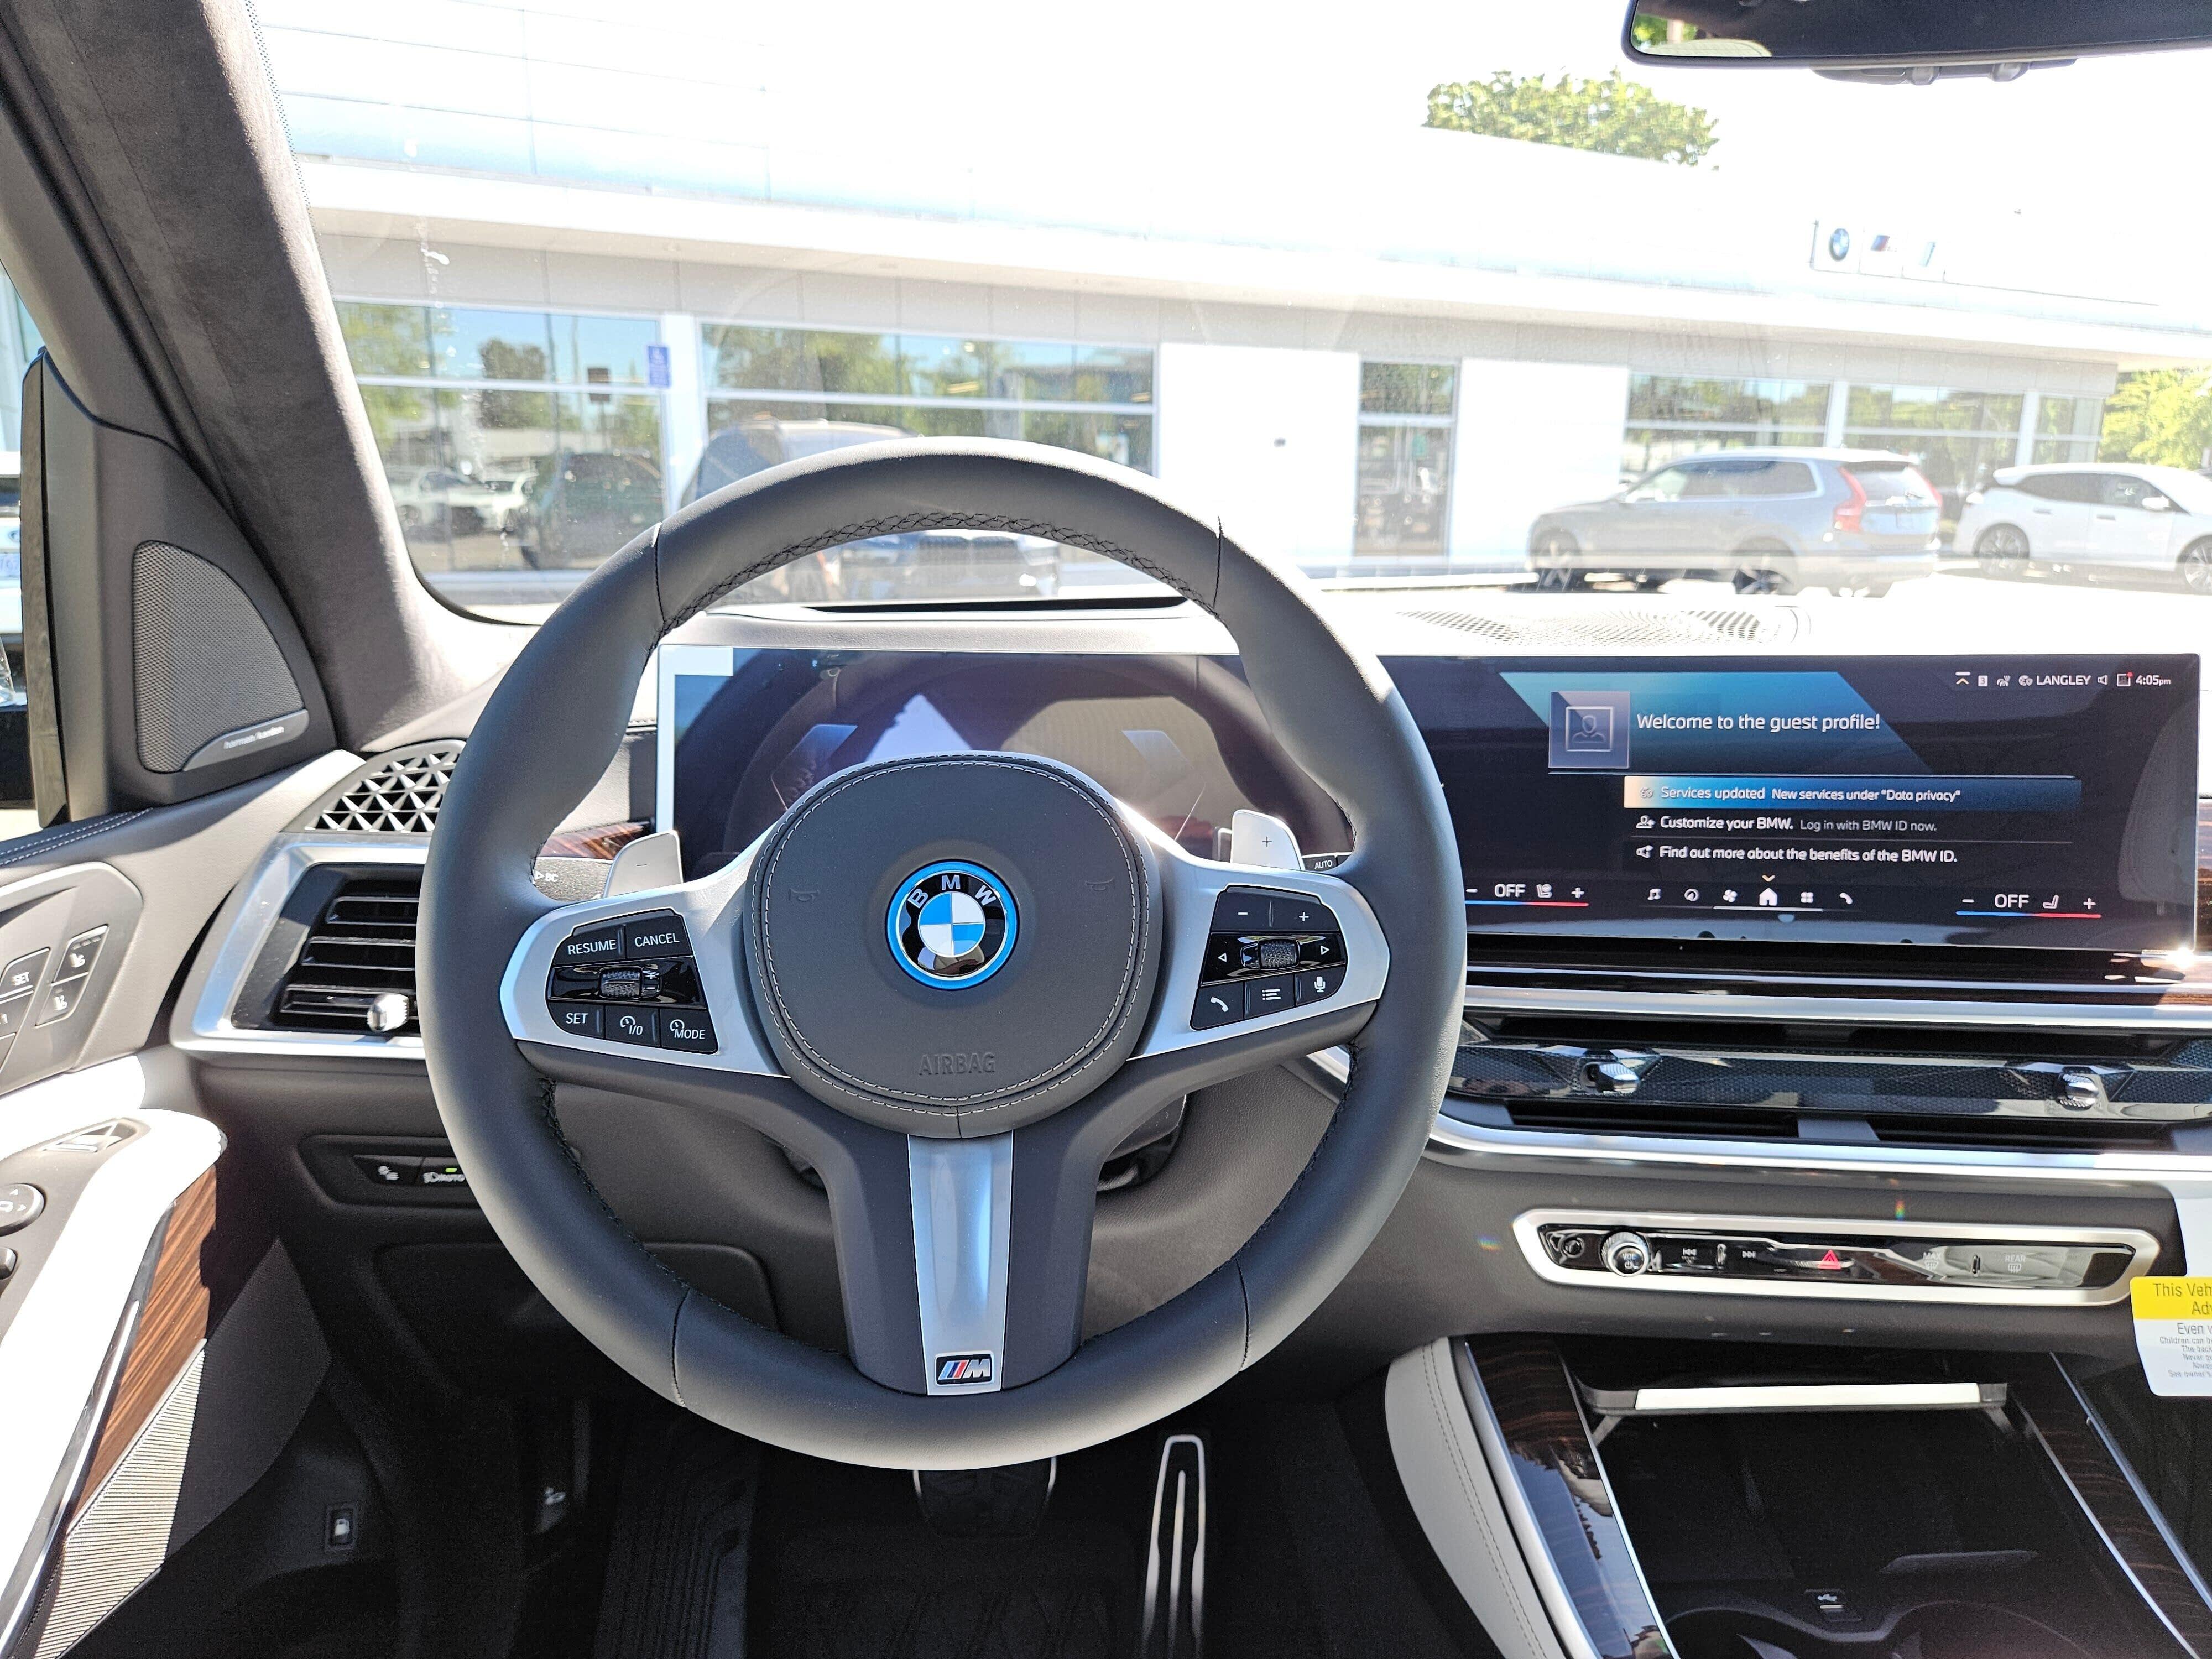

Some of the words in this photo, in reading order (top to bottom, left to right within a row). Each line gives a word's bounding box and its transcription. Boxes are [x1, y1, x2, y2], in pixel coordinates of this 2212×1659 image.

[2037, 675, 2091, 686] LANGLEY
[2135, 675, 2171, 686] 4:05pm
[1637, 714, 1713, 729] Welcome
[1718, 716, 1734, 729] to
[1739, 714, 1766, 729] the
[1770, 716, 1818, 732] guest
[1822, 714, 1880, 732] profile!
[1661, 787, 1711, 799] Services
[1714, 787, 1765, 800] updated
[1772, 789, 1797, 800] New
[1799, 789, 1844, 800] services
[1846, 789, 1879, 800] under
[1660, 816, 1724, 828] Customize
[1726, 818, 1755, 831] your
[1756, 817, 1793, 829] BMW.
[1800, 820, 1821, 832] Log
[1823, 820, 1833, 830] in
[1836, 820, 1859, 830] with
[1862, 820, 1892, 830] BMW
[1895, 821, 1907, 830] ID
[1910, 822, 1937, 831] now.
[1660, 846, 1688, 857] Find
[1689, 847, 1712, 858] out
[1713, 848, 1745, 859] more
[1747, 847, 1784, 860] about
[1786, 847, 1807, 860] the
[1809, 848, 1859, 861] benefits
[1862, 849, 1877, 862] of
[1877, 849, 1899, 862] the
[1901, 849, 1937, 862] BMW
[1940, 849, 1957, 862] ID.
[1314, 859, 1333, 870] AUTO
[545, 873, 559, 883] BC
[907, 875, 997, 909] BMW
[1494, 884, 1526, 898] OFF
[1995, 894, 2029, 908] OFF
[634, 933, 680, 947] CANCEL
[568, 940, 617, 955] RESUME
[12, 972, 29, 986] SET
[566, 1013, 588, 1024] SET
[674, 1029, 706, 1040] MODE
[919, 1052, 995, 1076] AIRBAG
[1923, 1251, 1942, 1260] MAX
[2005, 1255, 2026, 1263] REAR
[2153, 1283, 2182, 1297] This
[2177, 1323, 2204, 1334] Even
